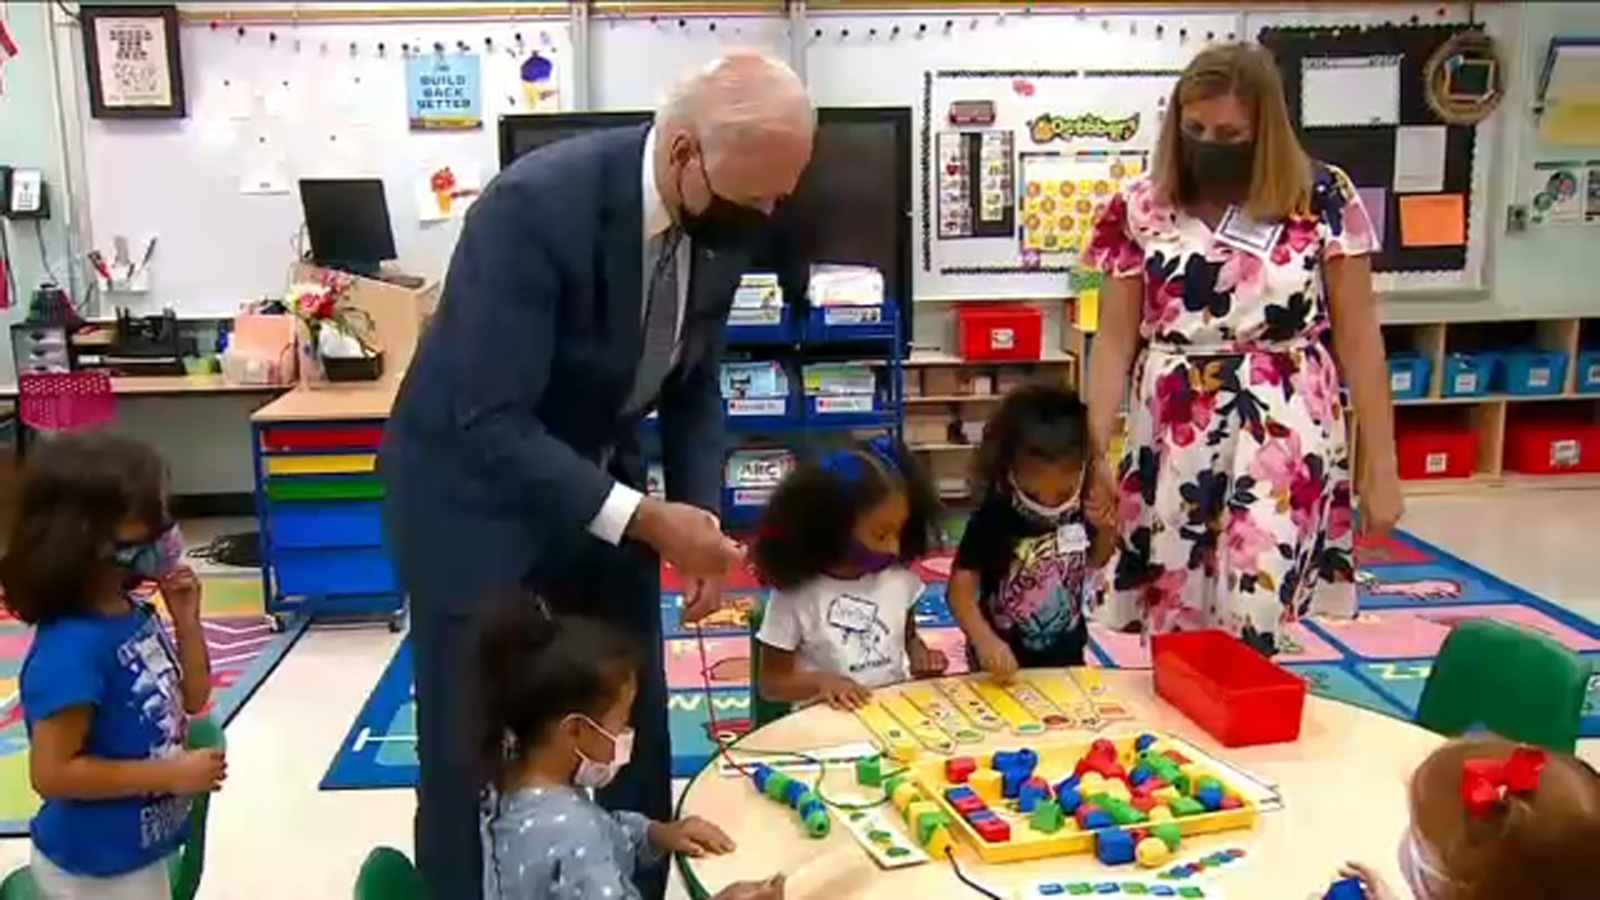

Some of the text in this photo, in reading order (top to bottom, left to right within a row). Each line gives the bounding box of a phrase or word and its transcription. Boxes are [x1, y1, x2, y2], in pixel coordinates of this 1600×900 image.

[420, 75, 466, 86] BUILD
[423, 87, 464, 98] BACK
[417, 99, 471, 109] BETTER
